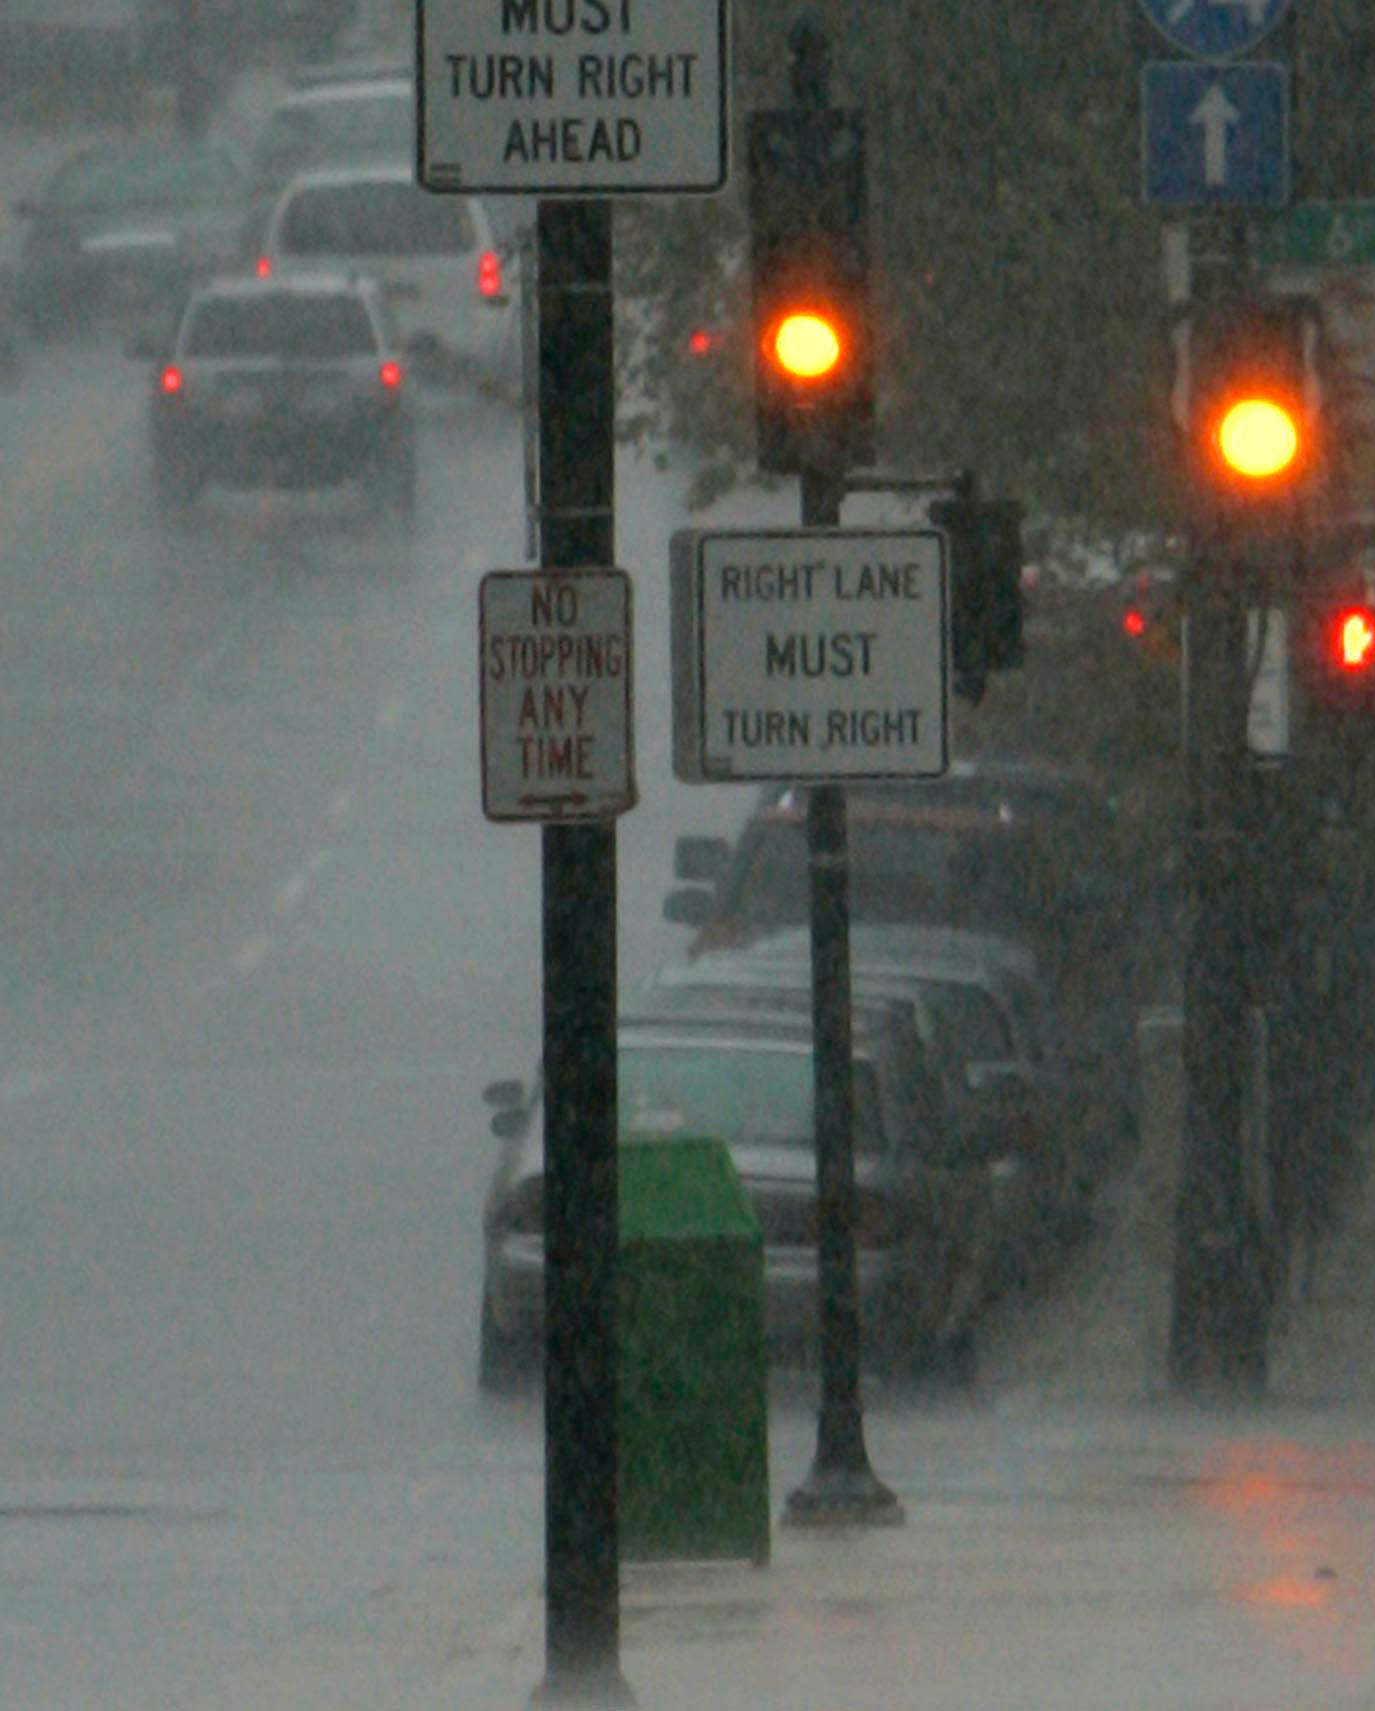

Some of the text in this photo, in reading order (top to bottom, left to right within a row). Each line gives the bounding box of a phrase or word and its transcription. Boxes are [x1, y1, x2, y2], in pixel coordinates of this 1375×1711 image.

[501, 0, 635, 34] MUST
[445, 55, 697, 98] TURN RIGHT
[503, 118, 642, 162] AHEAD
[721, 564, 921, 599] RIGHT LANE
[531, 583, 578, 627] NO
[489, 634, 623, 680] STOPPING
[765, 634, 878, 677] MUST
[519, 686, 590, 730] ANY
[722, 710, 922, 748] TURN RIGHT
[518, 737, 595, 780] TIME
